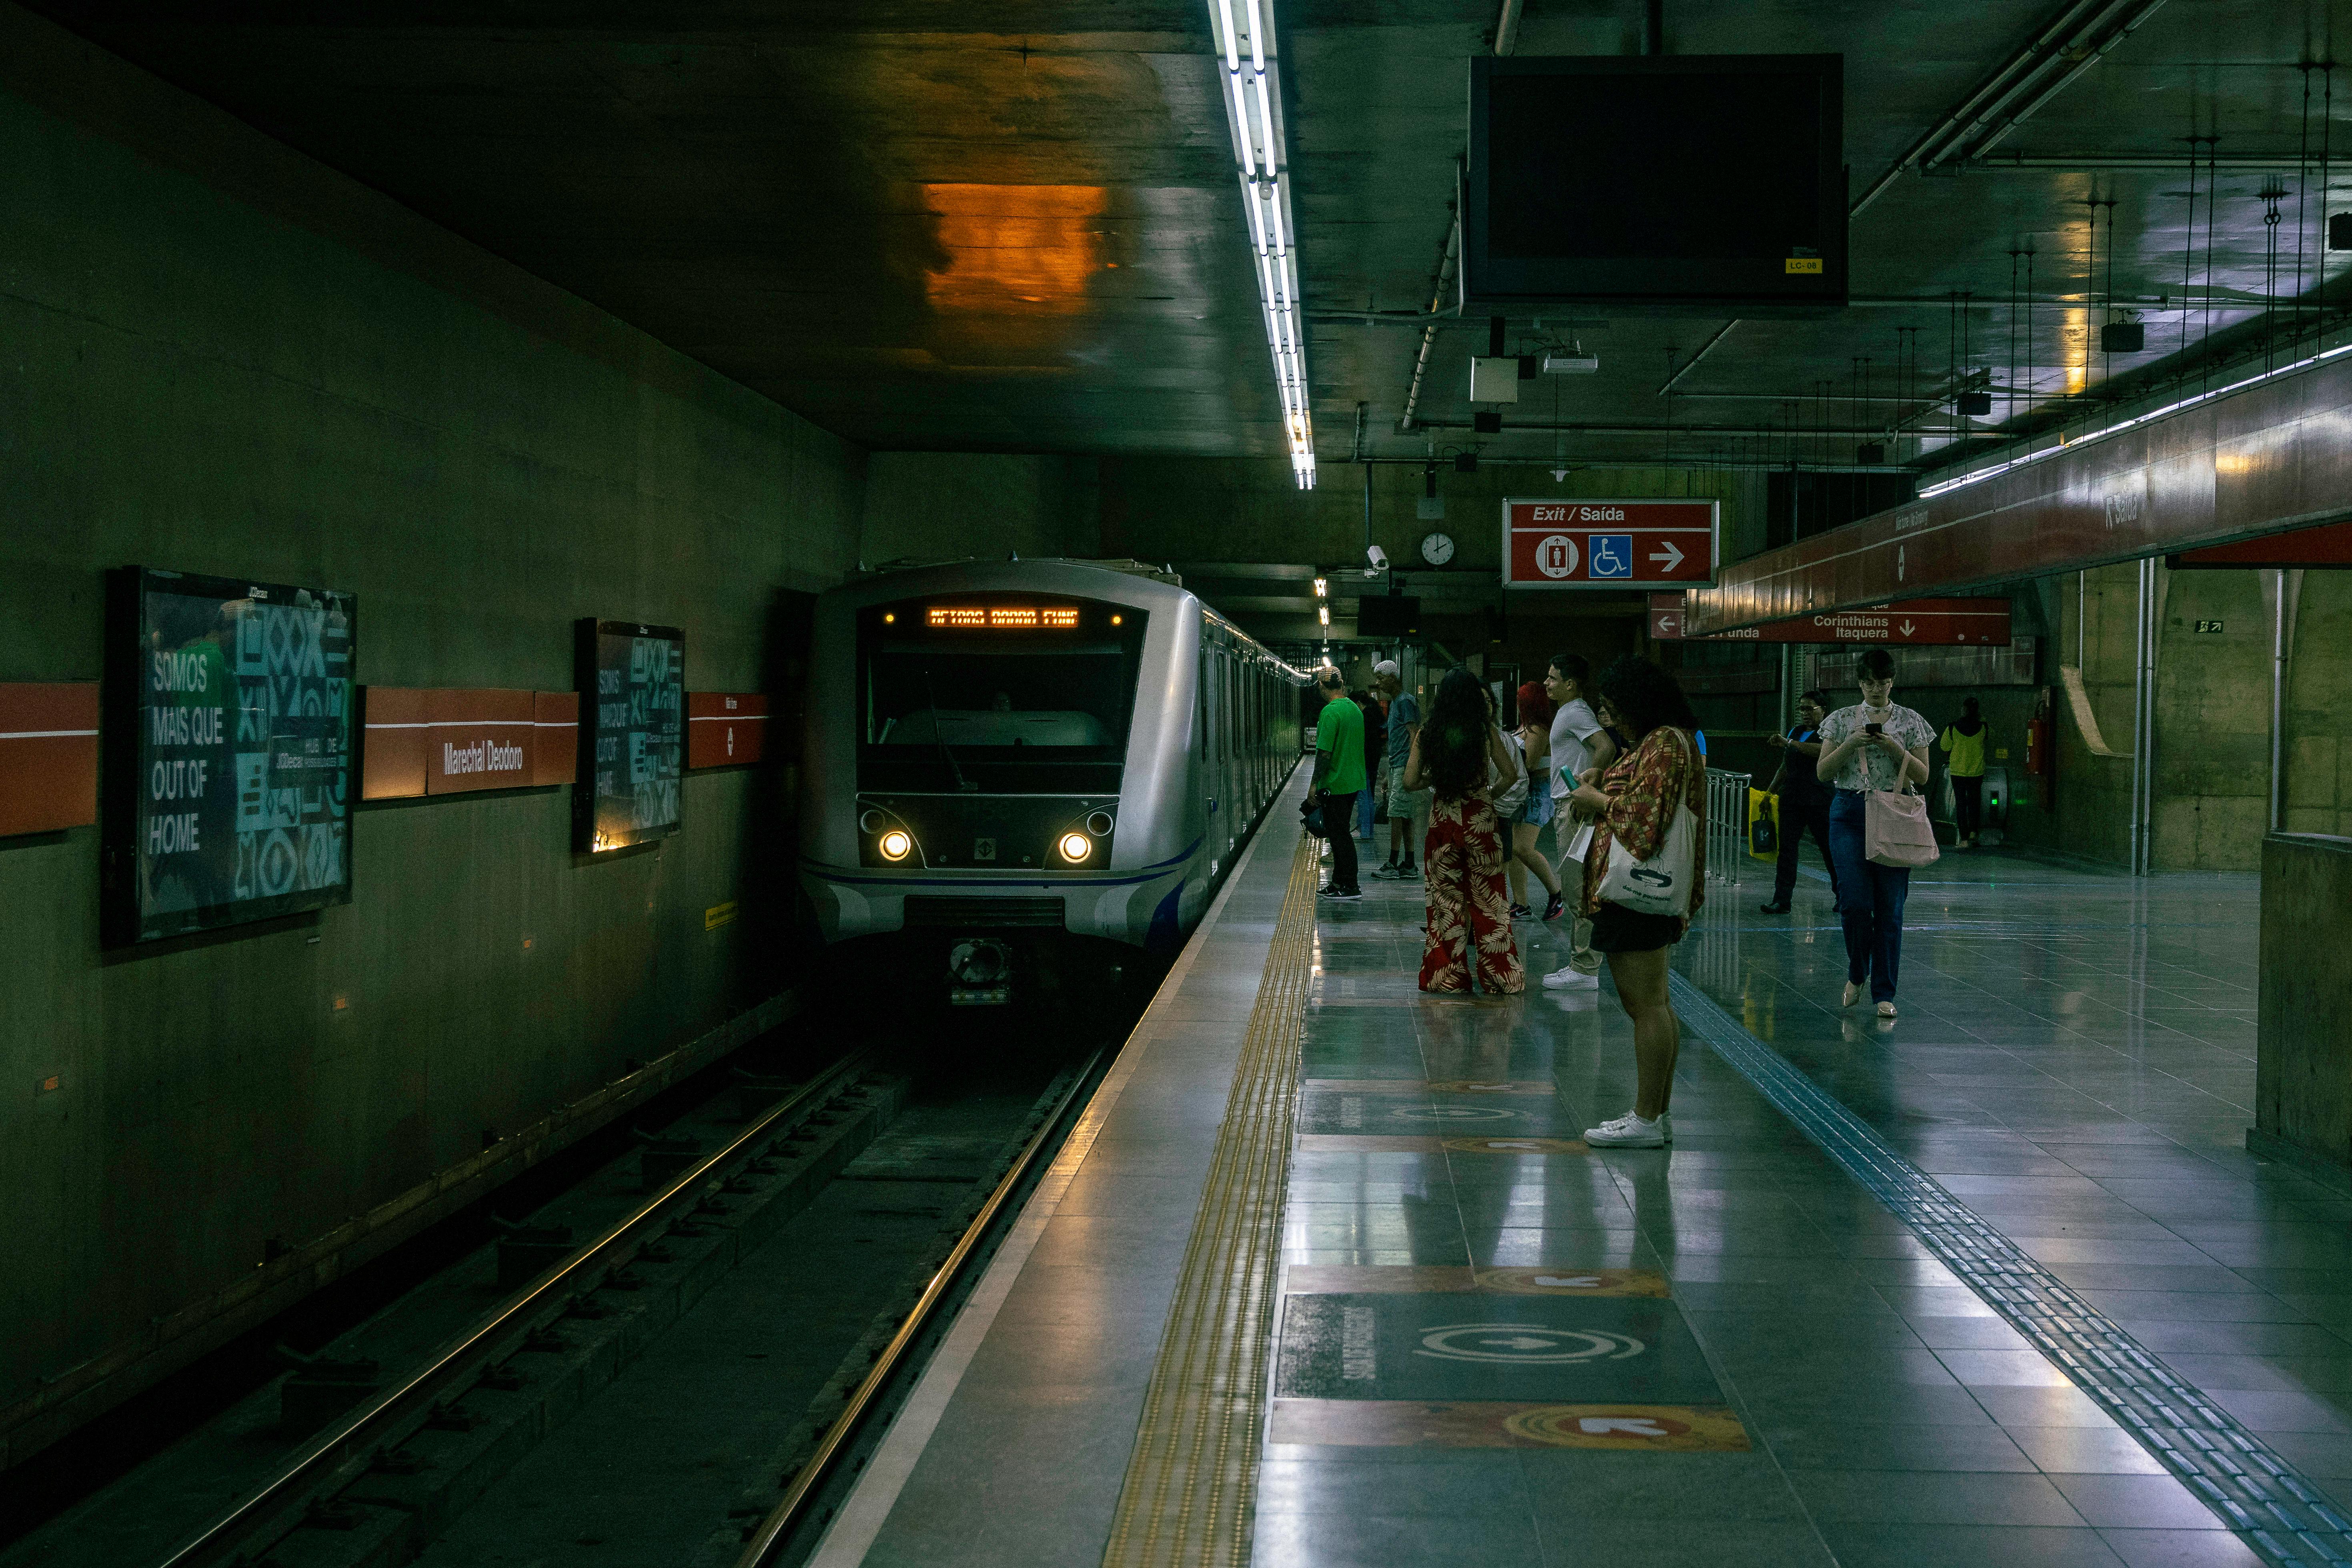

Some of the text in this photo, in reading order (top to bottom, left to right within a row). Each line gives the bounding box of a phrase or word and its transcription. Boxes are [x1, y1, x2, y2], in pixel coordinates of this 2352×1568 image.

[1533, 506, 1625, 521] Exit / Saída
[1813, 615, 1889, 627] Corinthians
[1836, 626, 1888, 640] Itaquera
[153, 651, 208, 693] SOMOS
[153, 706, 224, 746] MAIS QUE
[444, 739, 523, 775] Marechal Deodoro
[151, 759, 207, 801] OUT OF
[148, 813, 200, 855] HOME
